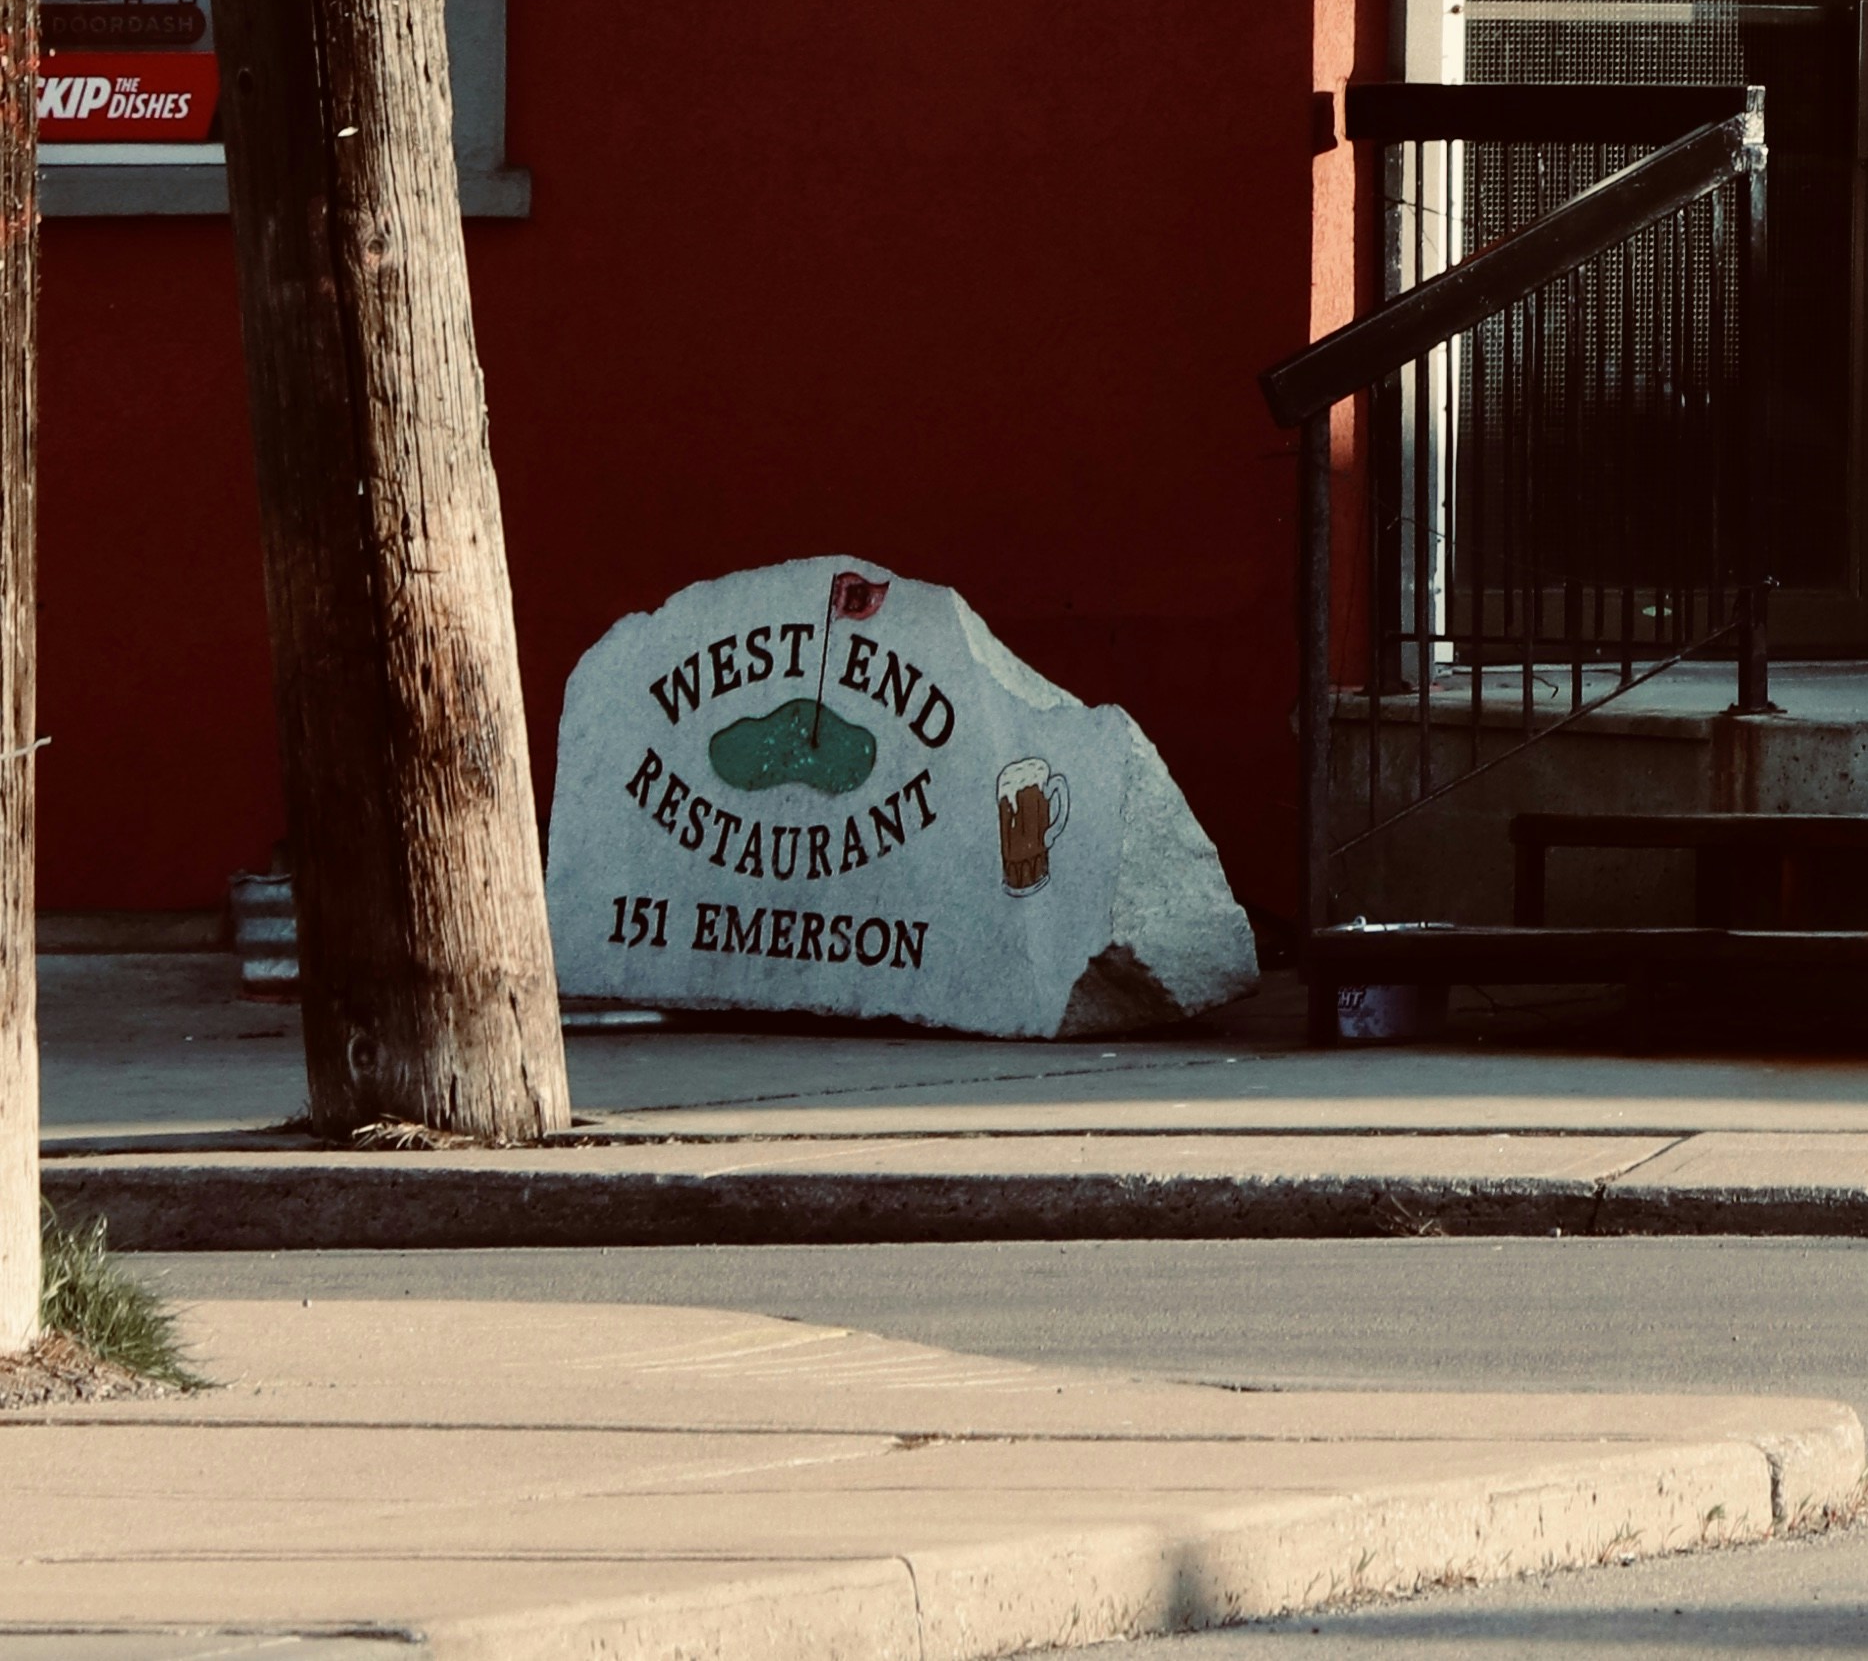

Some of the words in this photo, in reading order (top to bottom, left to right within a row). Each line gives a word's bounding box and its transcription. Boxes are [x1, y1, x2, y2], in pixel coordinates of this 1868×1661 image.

[52, 16, 194, 34] DOORDASH
[107, 93, 192, 119] DISHES
[115, 77, 141, 93] THE
[649, 623, 815, 726] WEST
[838, 633, 956, 749] END
[625, 747, 938, 881] RESTAURANT
[607, 895, 669, 949] 151
[691, 902, 930, 970] EMERSON
